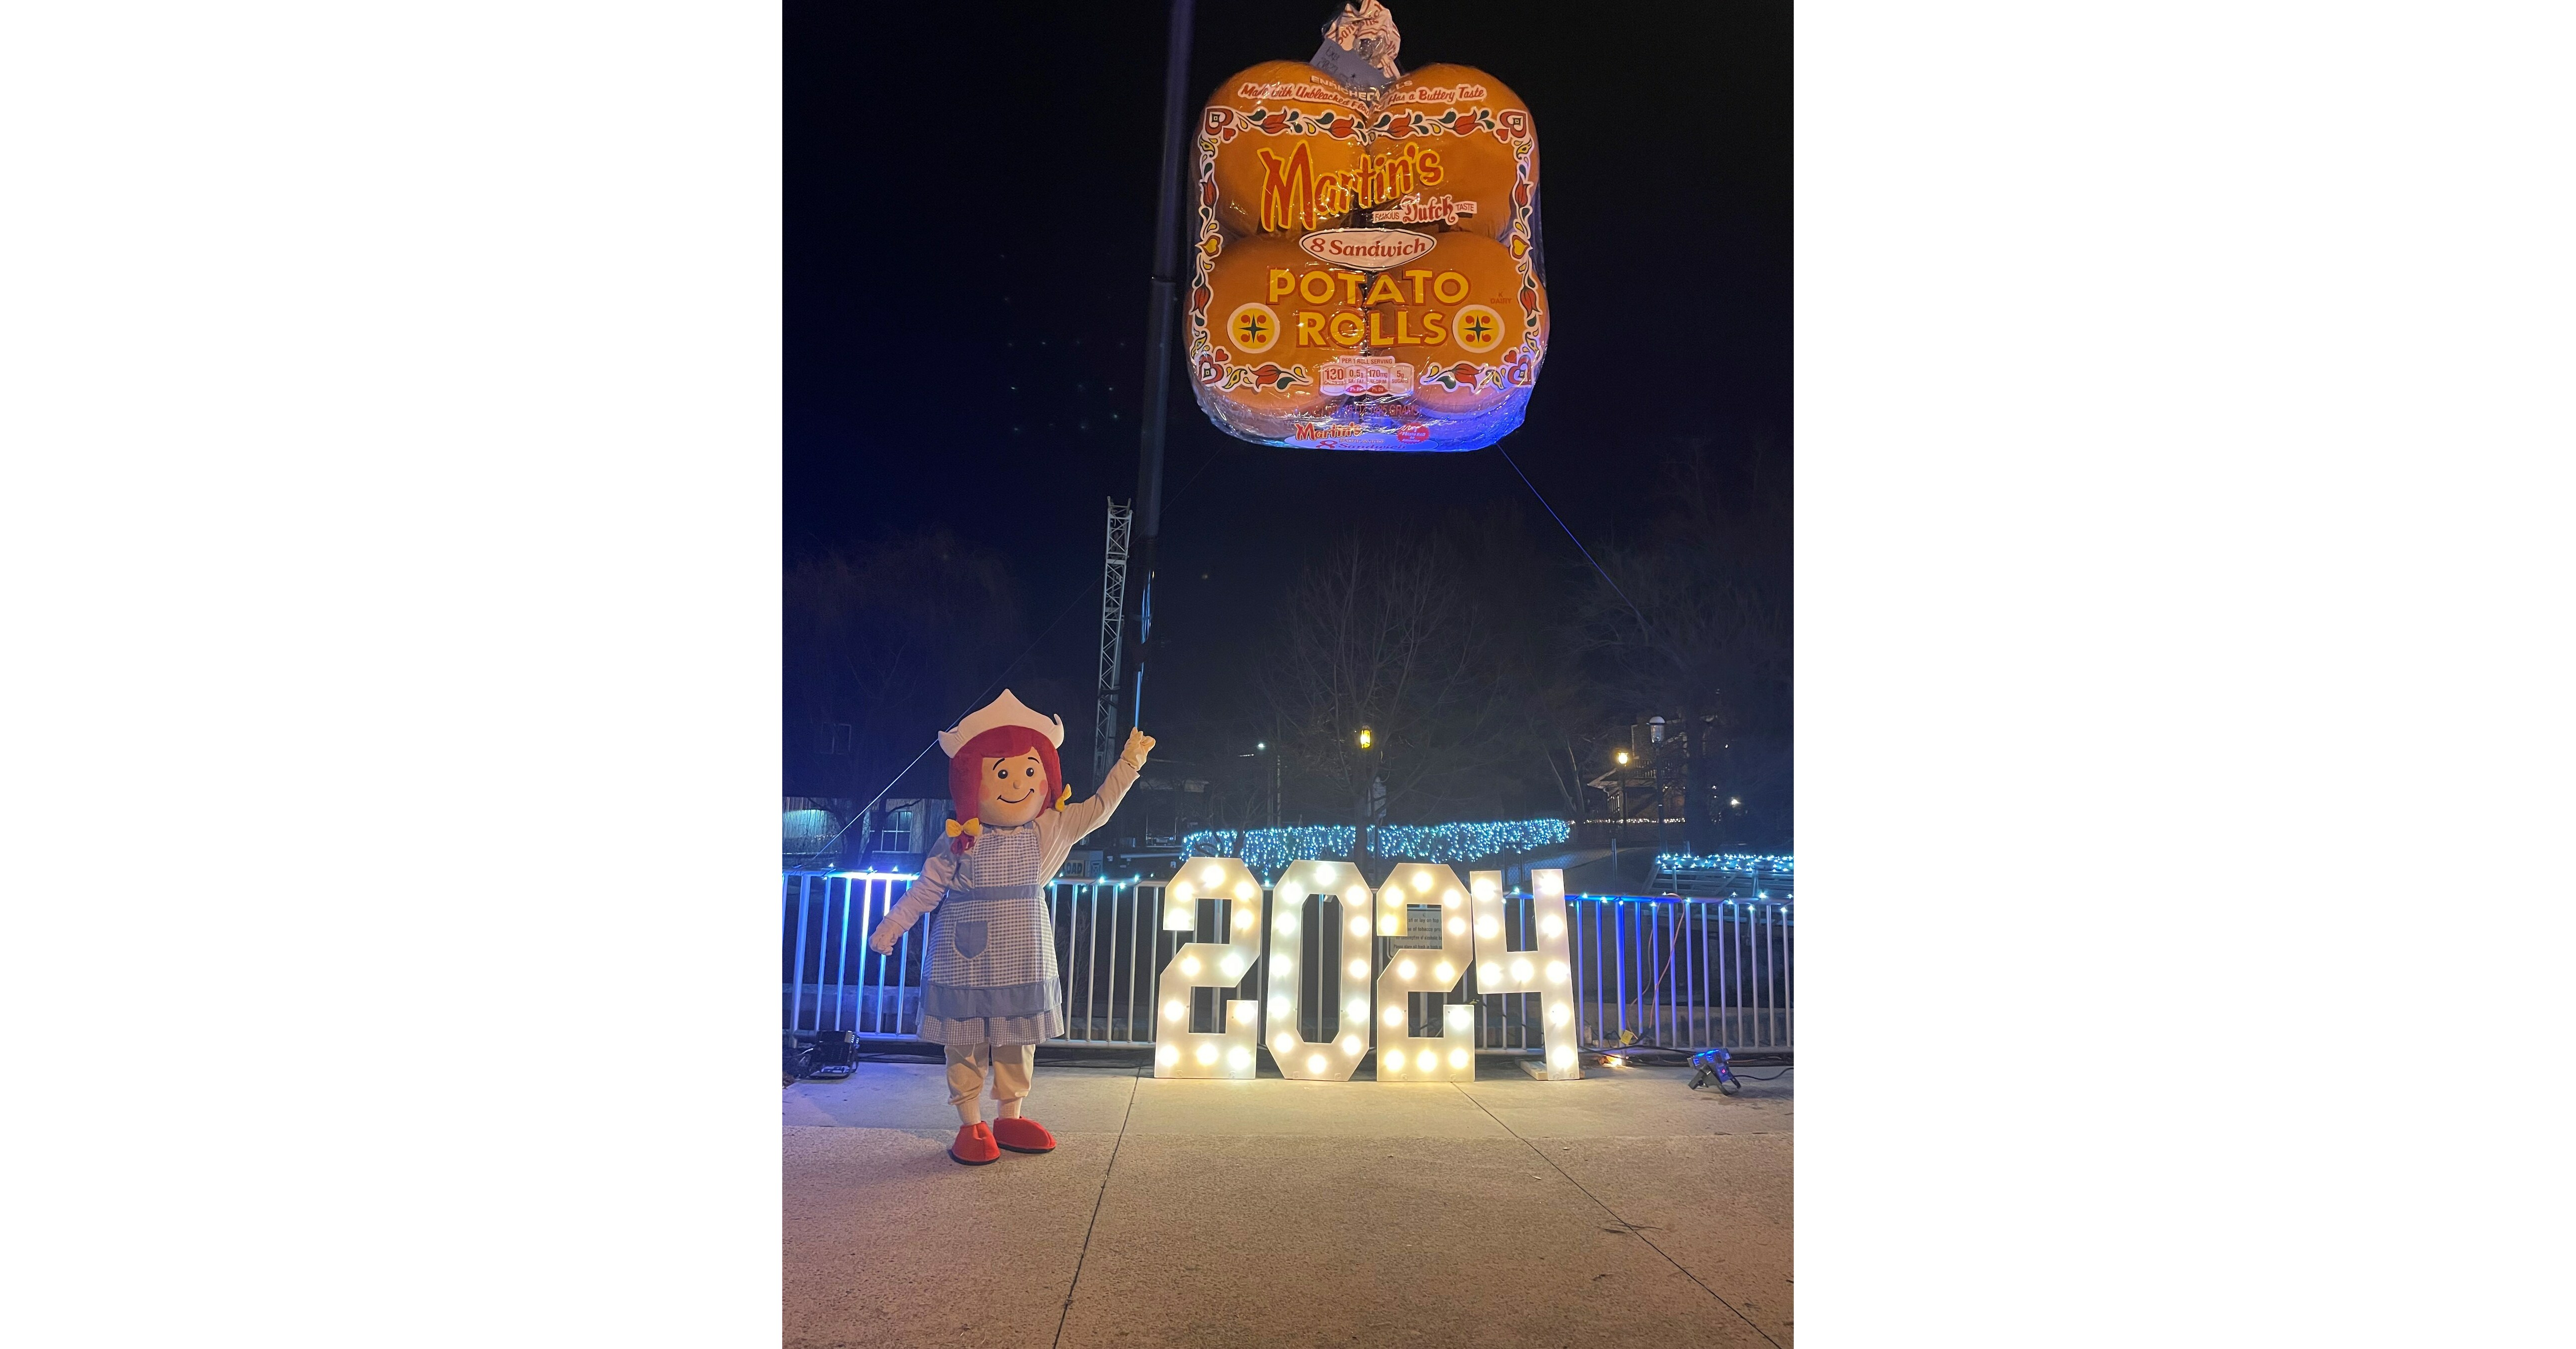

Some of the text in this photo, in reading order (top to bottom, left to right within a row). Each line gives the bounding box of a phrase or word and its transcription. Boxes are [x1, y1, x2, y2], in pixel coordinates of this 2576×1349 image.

[1241, 84, 1267, 97] Made
[1296, 86, 1350, 105] Unbleached
[1351, 101, 1370, 116] Flou
[1389, 93, 1405, 103] Has
[1419, 89, 1456, 103] Buttery
[1458, 86, 1485, 98] Taste
[1257, 139, 1444, 232] Martin's
[1375, 198, 1475, 223] FAMOUS Dutch TASTE
[1310, 237, 1426, 257] 8 Sandwich
[1266, 267, 1472, 307] POTATO
[1297, 309, 1450, 348] ROLLS
[1324, 368, 1344, 380] 130
[1349, 369, 1364, 378] 0.5g
[1368, 369, 1388, 378] 170mg
[1294, 421, 1363, 441] Martin's
[1154, 856, 1580, 1082] 2024
